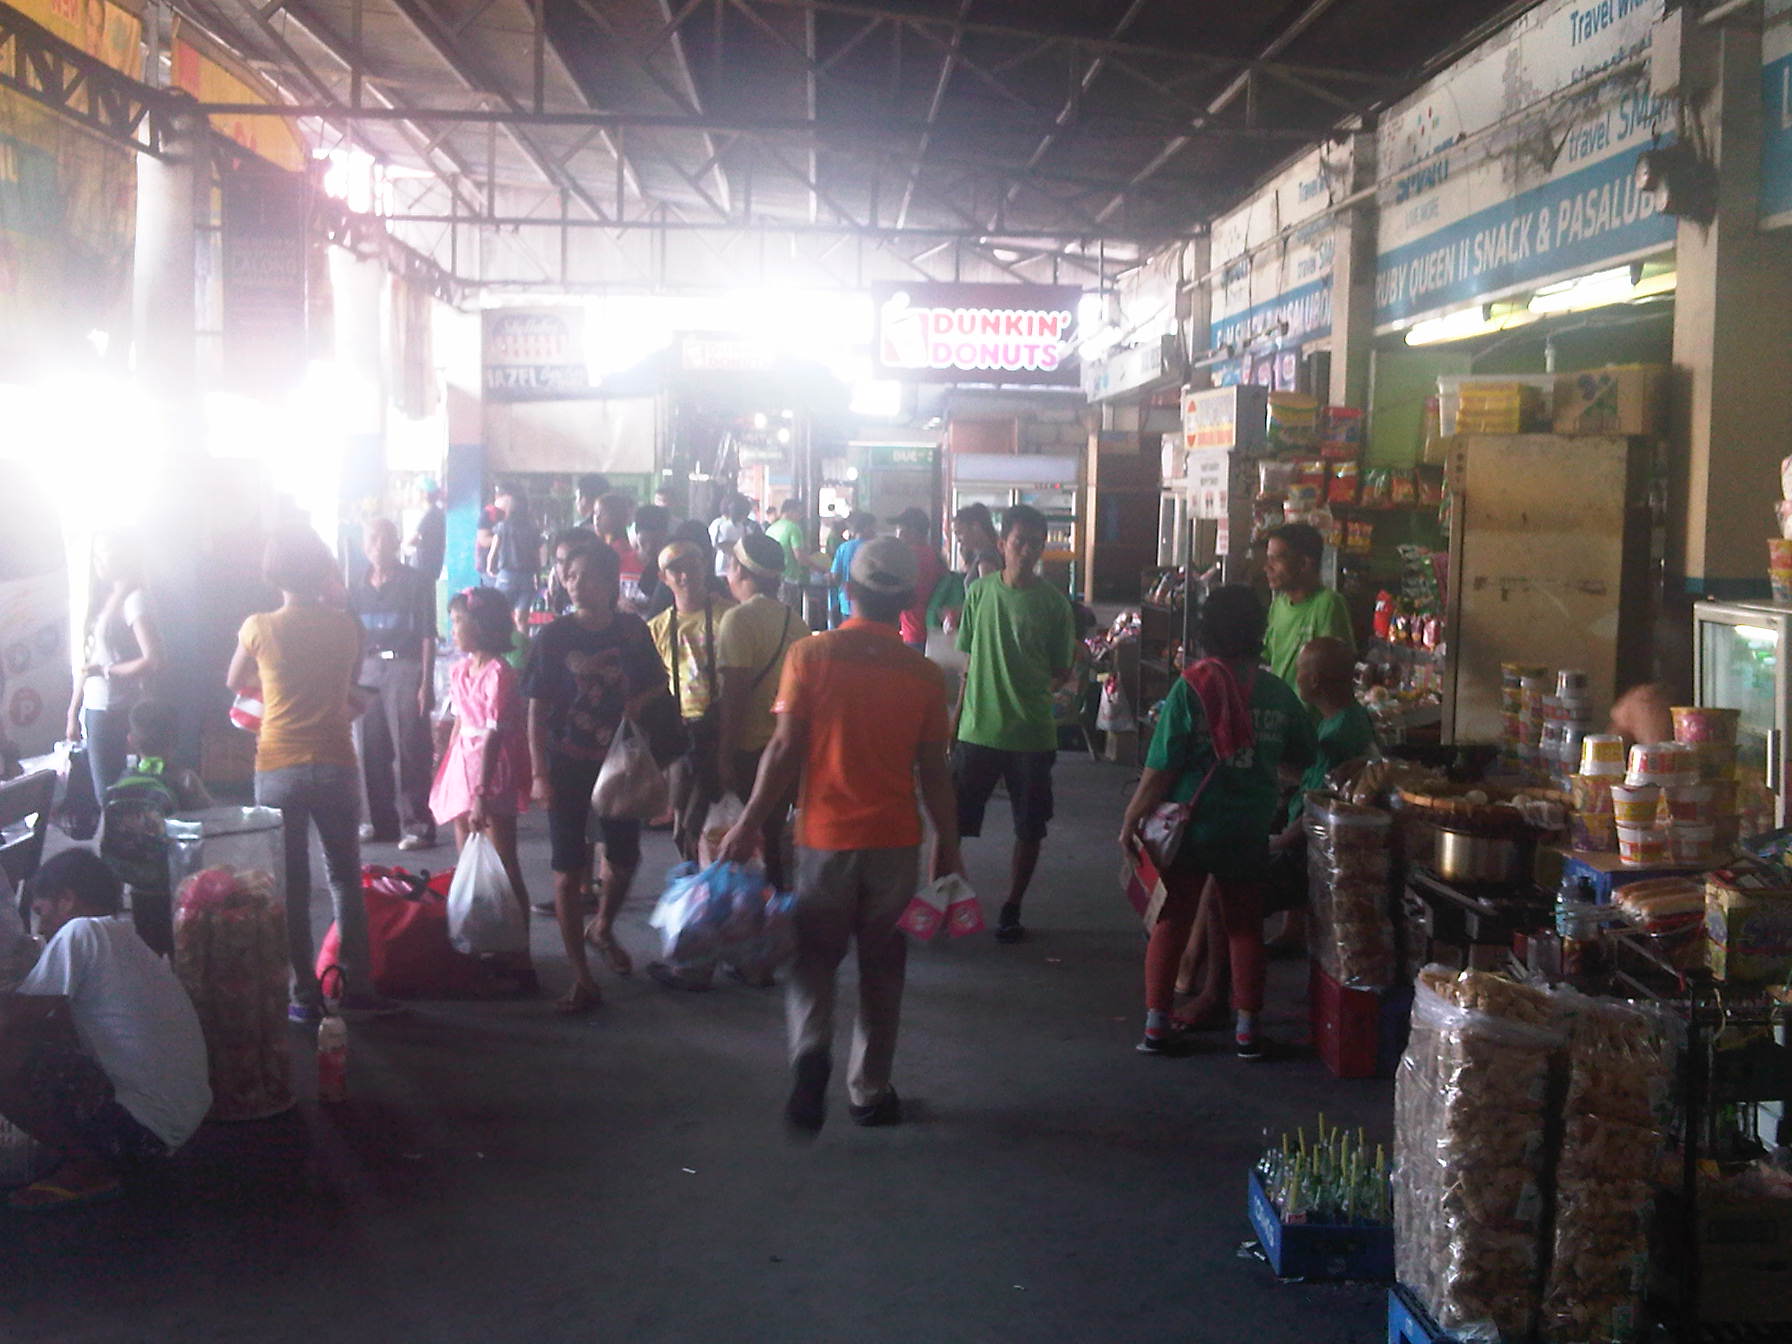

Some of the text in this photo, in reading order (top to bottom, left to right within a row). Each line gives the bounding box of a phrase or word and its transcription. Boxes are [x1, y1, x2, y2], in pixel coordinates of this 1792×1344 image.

[1570, 0, 1614, 47] Travel
[1568, 110, 1611, 162] travel
[1375, 263, 1406, 307] RUBY
[1408, 246, 1455, 304] QUEEN
[1472, 213, 1533, 277] SNACK
[1535, 206, 1552, 253] &
[1555, 172, 1656, 248] PASALUB
[933, 312, 1070, 337] DUNKIN'
[932, 341, 1058, 367] DONUTS
